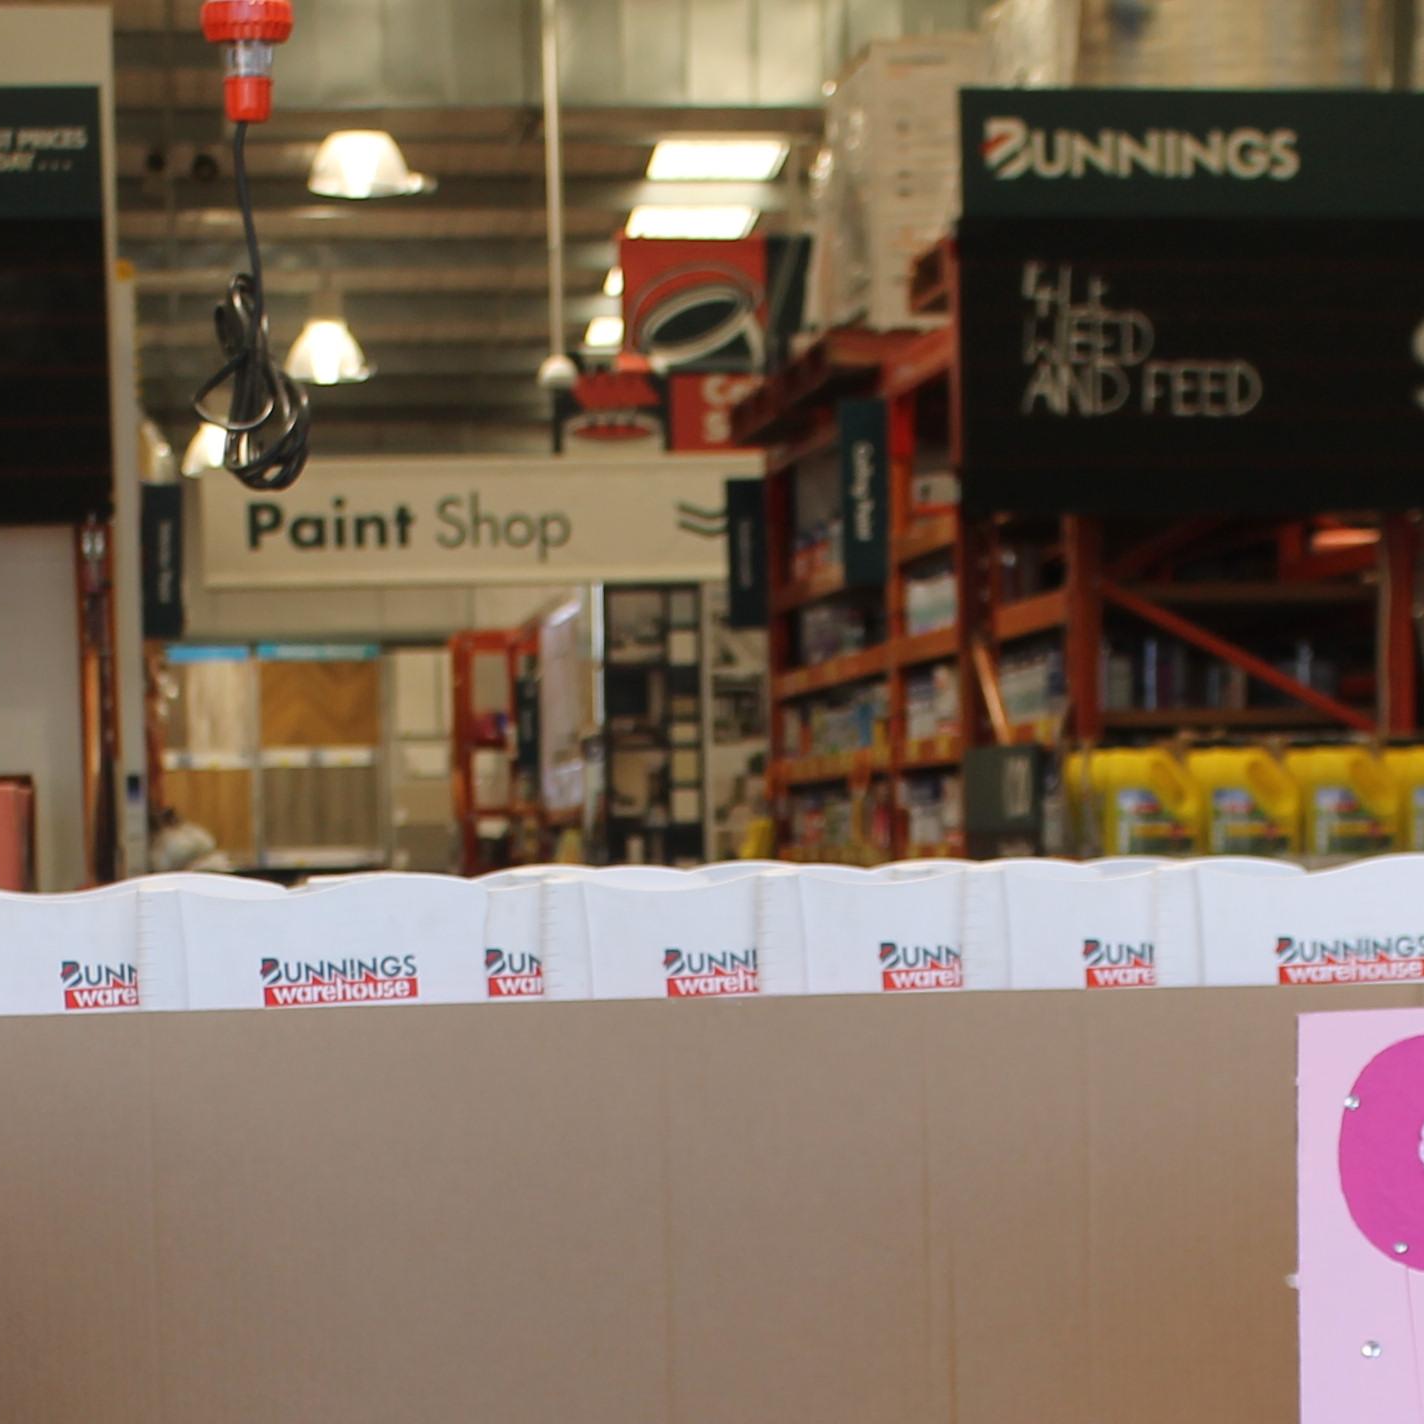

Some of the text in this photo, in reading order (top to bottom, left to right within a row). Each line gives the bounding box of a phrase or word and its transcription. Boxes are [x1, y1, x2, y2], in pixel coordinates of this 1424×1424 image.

[982, 118, 1299, 180] BUNNINGS
[1141, 359, 1264, 418] FEED
[248, 494, 572, 562] Paint Shop
[1083, 939, 1154, 967] BUN
[260, 955, 418, 985] BUNNINGS
[1285, 957, 1424, 983] warehouse
[272, 978, 412, 1005] warehouse
